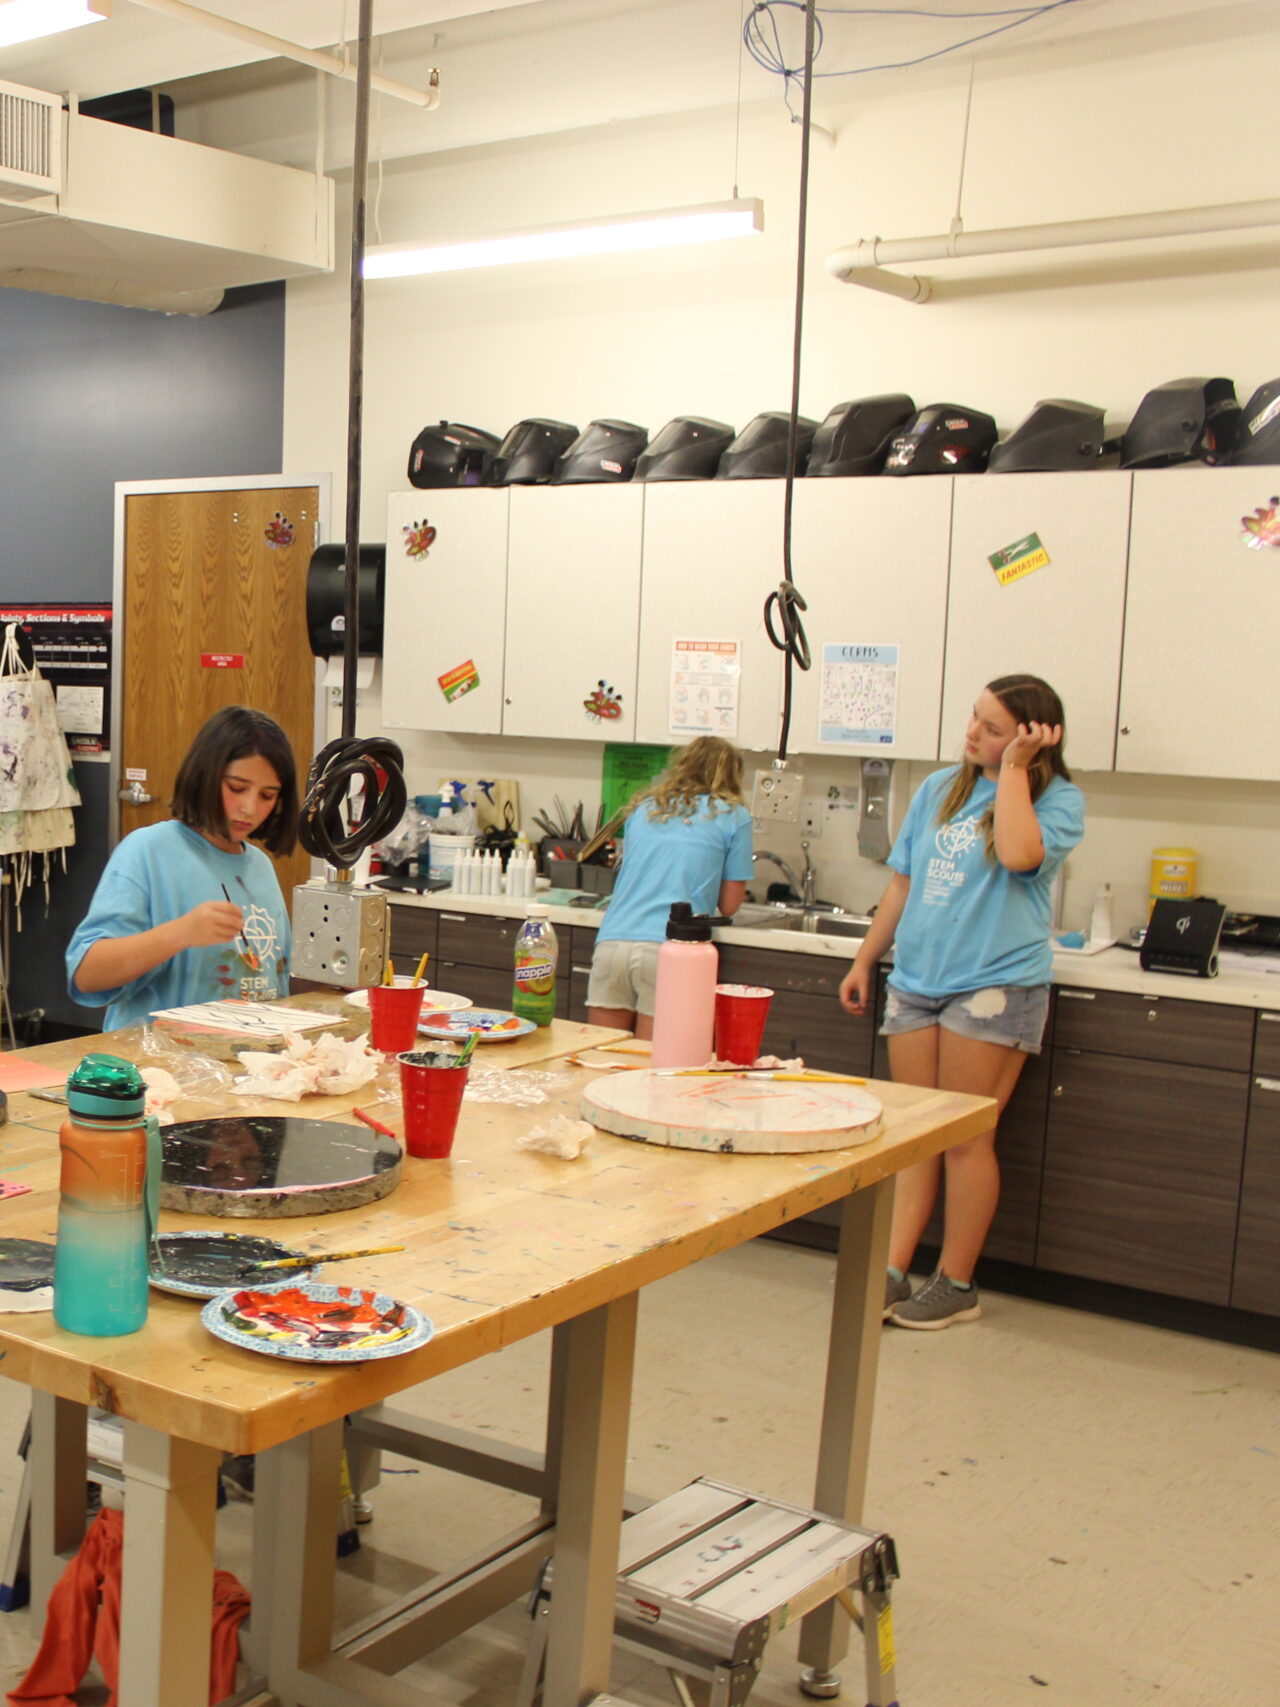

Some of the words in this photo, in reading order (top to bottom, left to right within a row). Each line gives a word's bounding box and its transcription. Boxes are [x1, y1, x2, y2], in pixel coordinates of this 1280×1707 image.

[26, 614, 61, 622] Sections
[69, 614, 105, 624] Symbols
[842, 646, 878, 657] GERMS
[929, 858, 955, 870] STEM
[927, 869, 965, 881] SCOUTS
[240, 977, 268, 990] STEM
